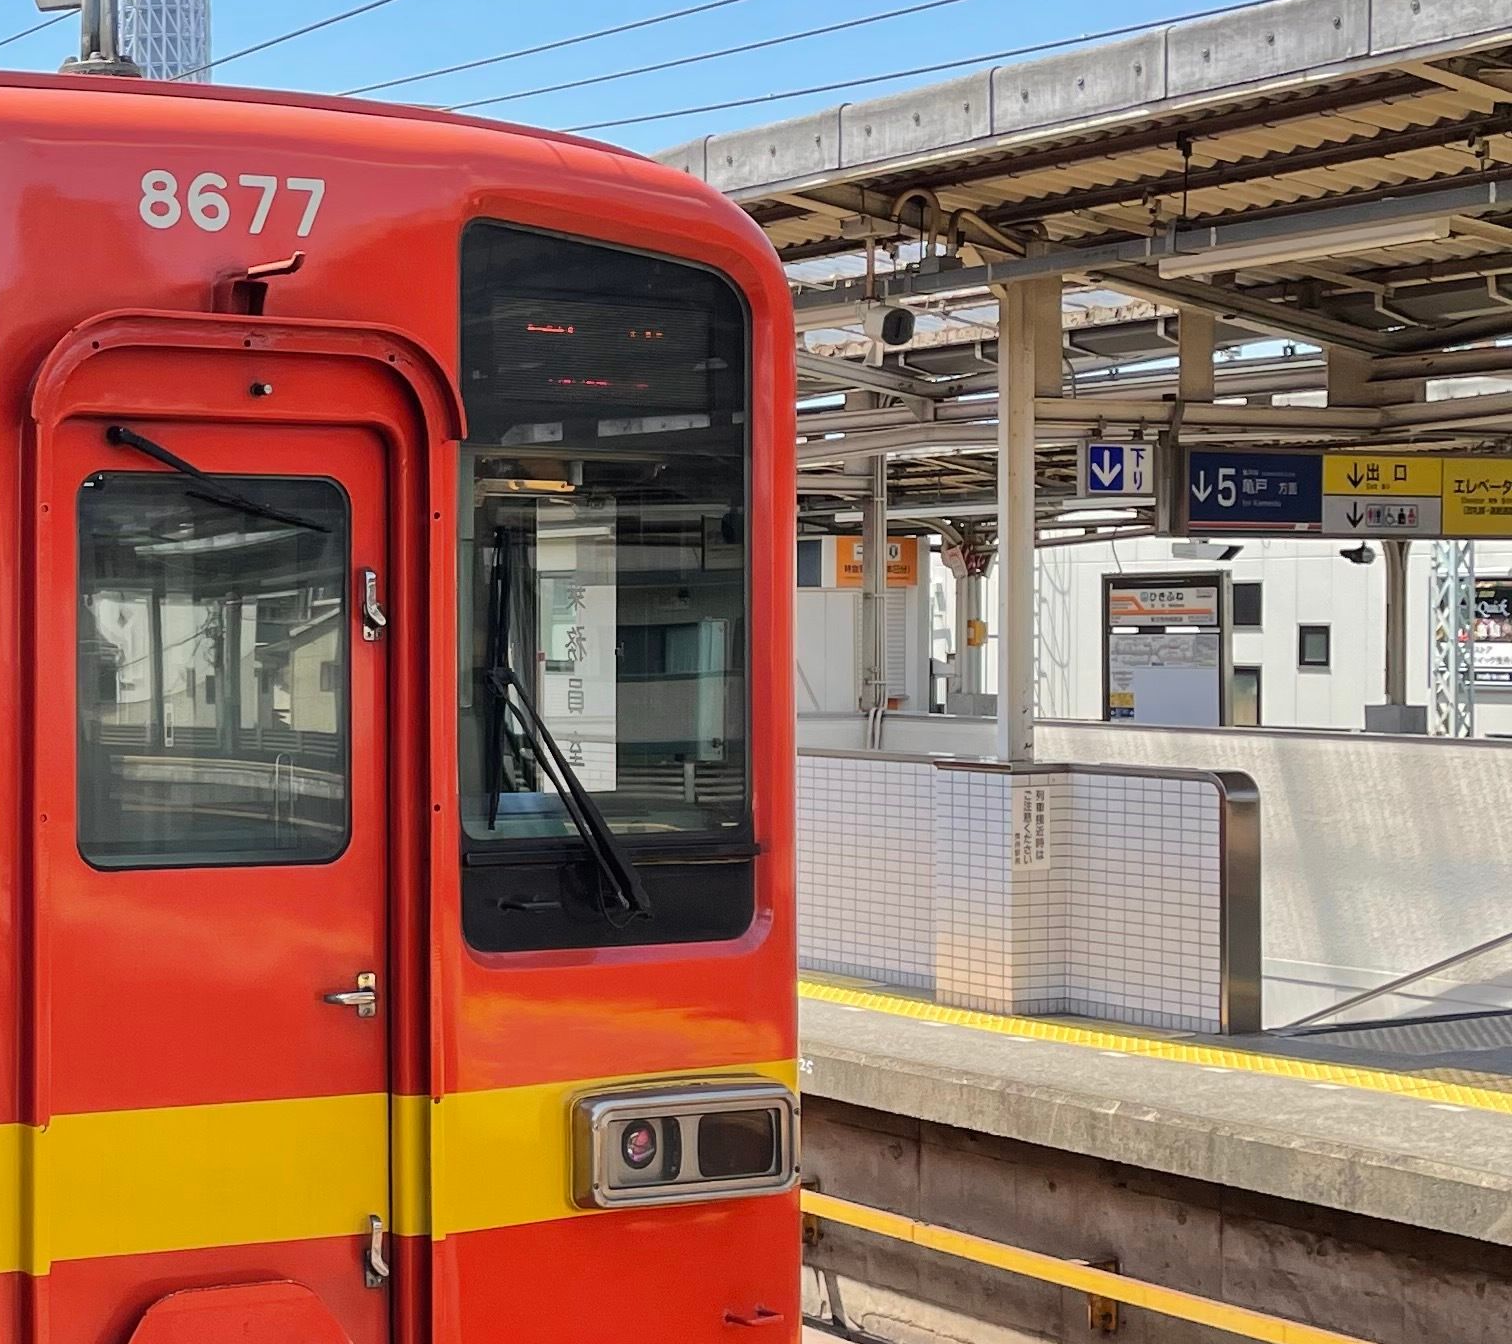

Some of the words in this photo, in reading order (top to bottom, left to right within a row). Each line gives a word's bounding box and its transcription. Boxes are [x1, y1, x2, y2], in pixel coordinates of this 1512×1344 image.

[139, 169, 326, 238] 8677
[1130, 448, 1146, 491] 下り
[1217, 467, 1237, 507] 5
[1366, 463, 1408, 482] 出口
[1149, 591, 1184, 602] ひきふね
